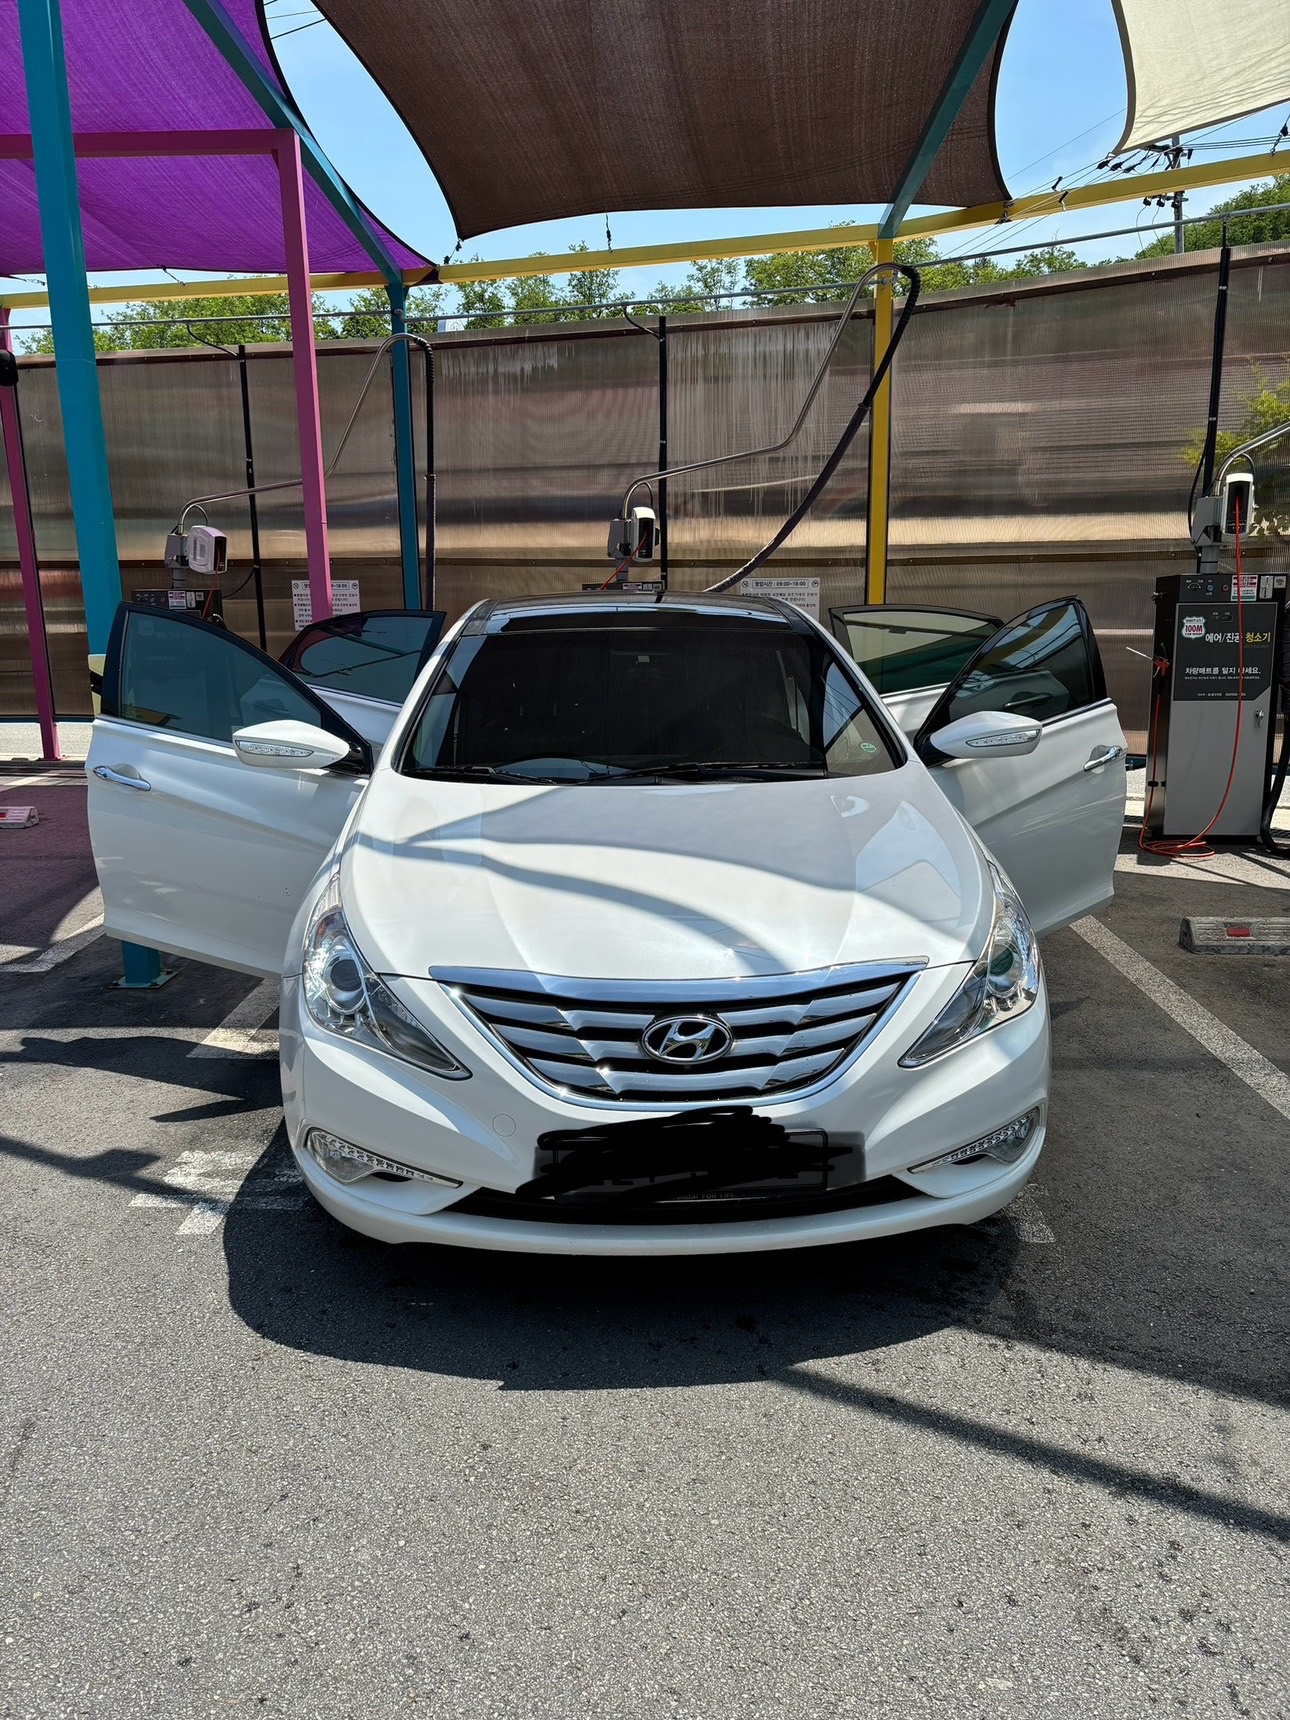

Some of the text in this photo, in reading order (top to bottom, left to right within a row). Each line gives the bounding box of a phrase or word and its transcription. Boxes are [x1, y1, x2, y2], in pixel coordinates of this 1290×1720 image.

[1186, 624, 1203, 632] 100M
[1205, 632, 1270, 643] 에어/진공 청소기
